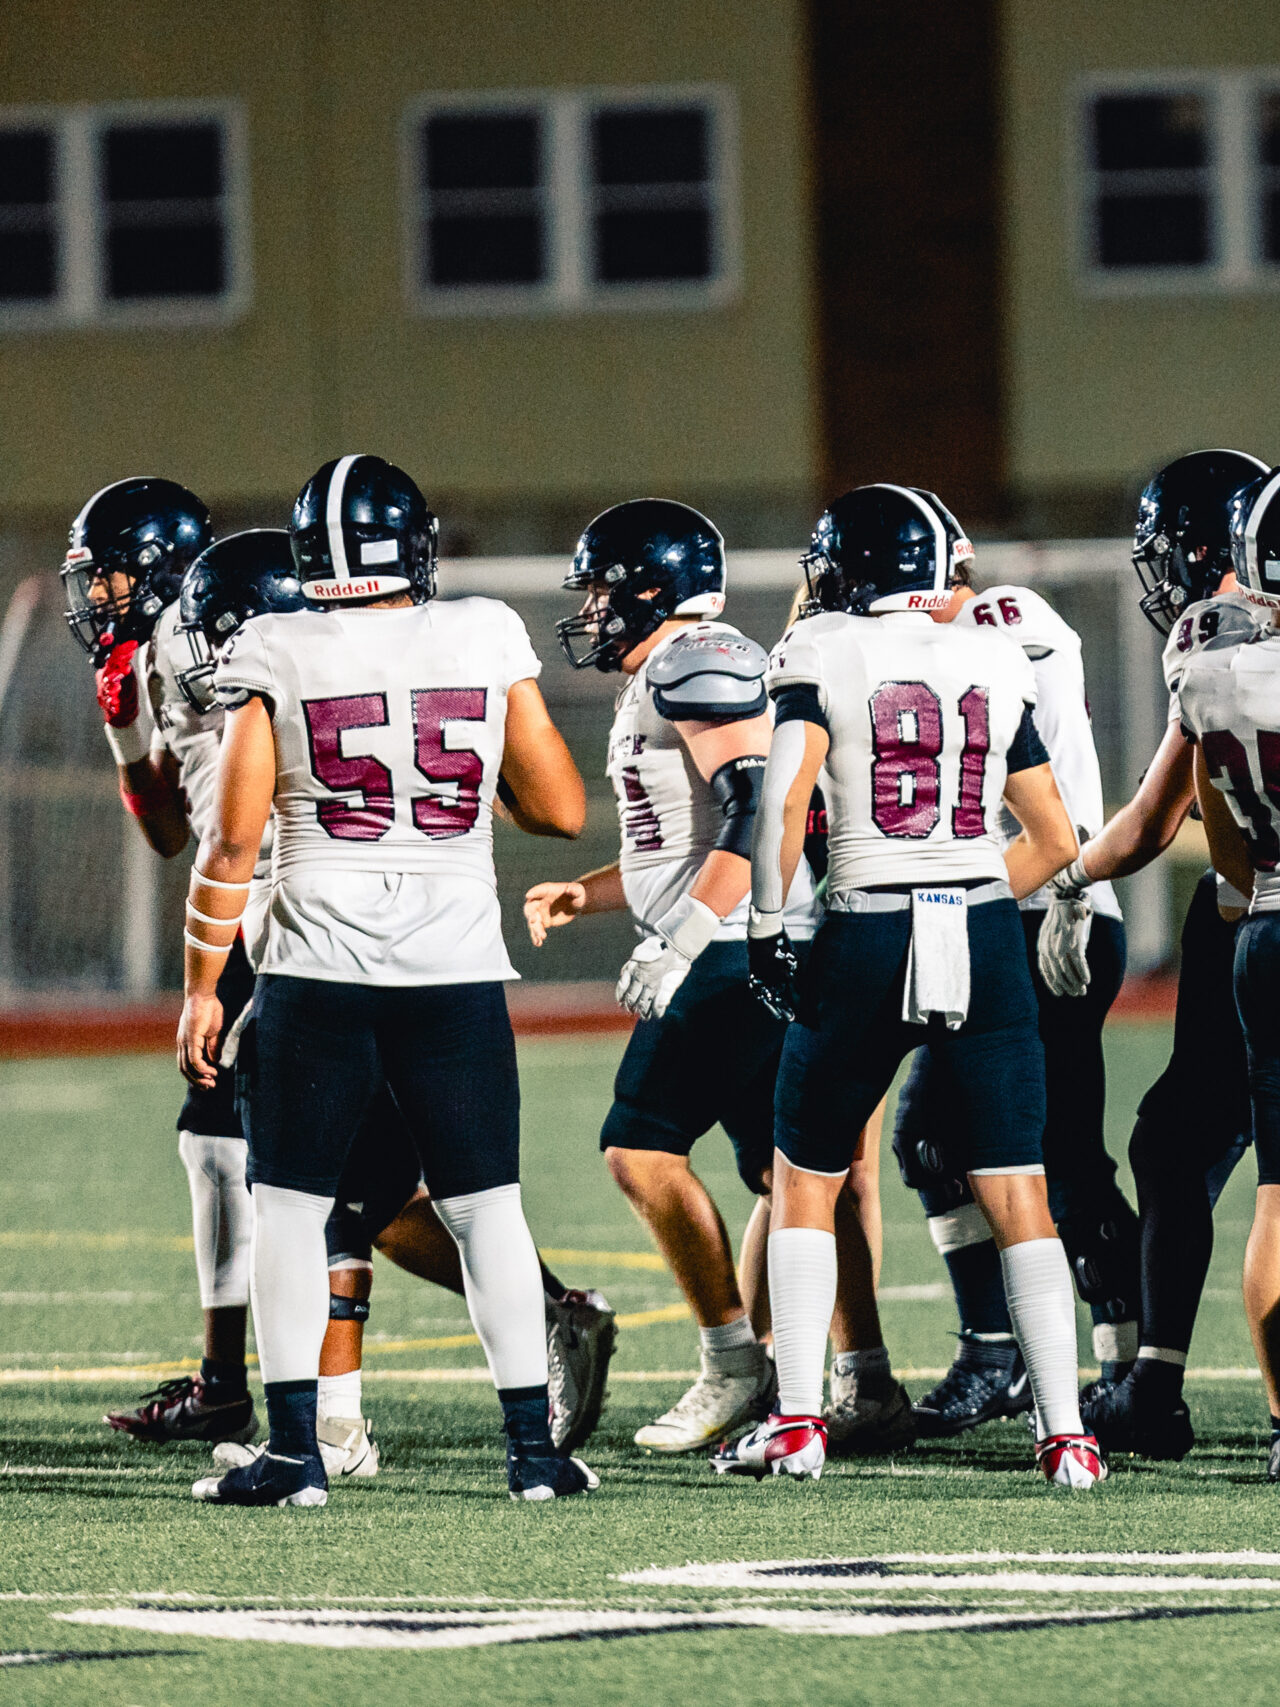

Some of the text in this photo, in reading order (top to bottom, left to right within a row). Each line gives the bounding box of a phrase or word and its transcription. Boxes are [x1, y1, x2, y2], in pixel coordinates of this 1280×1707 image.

[314, 580, 380, 598] Riddell
[972, 596, 1022, 628] 66
[300, 686, 489, 842] 55
[868, 679, 991, 840] 81
[917, 892, 963, 906] KANSAS
